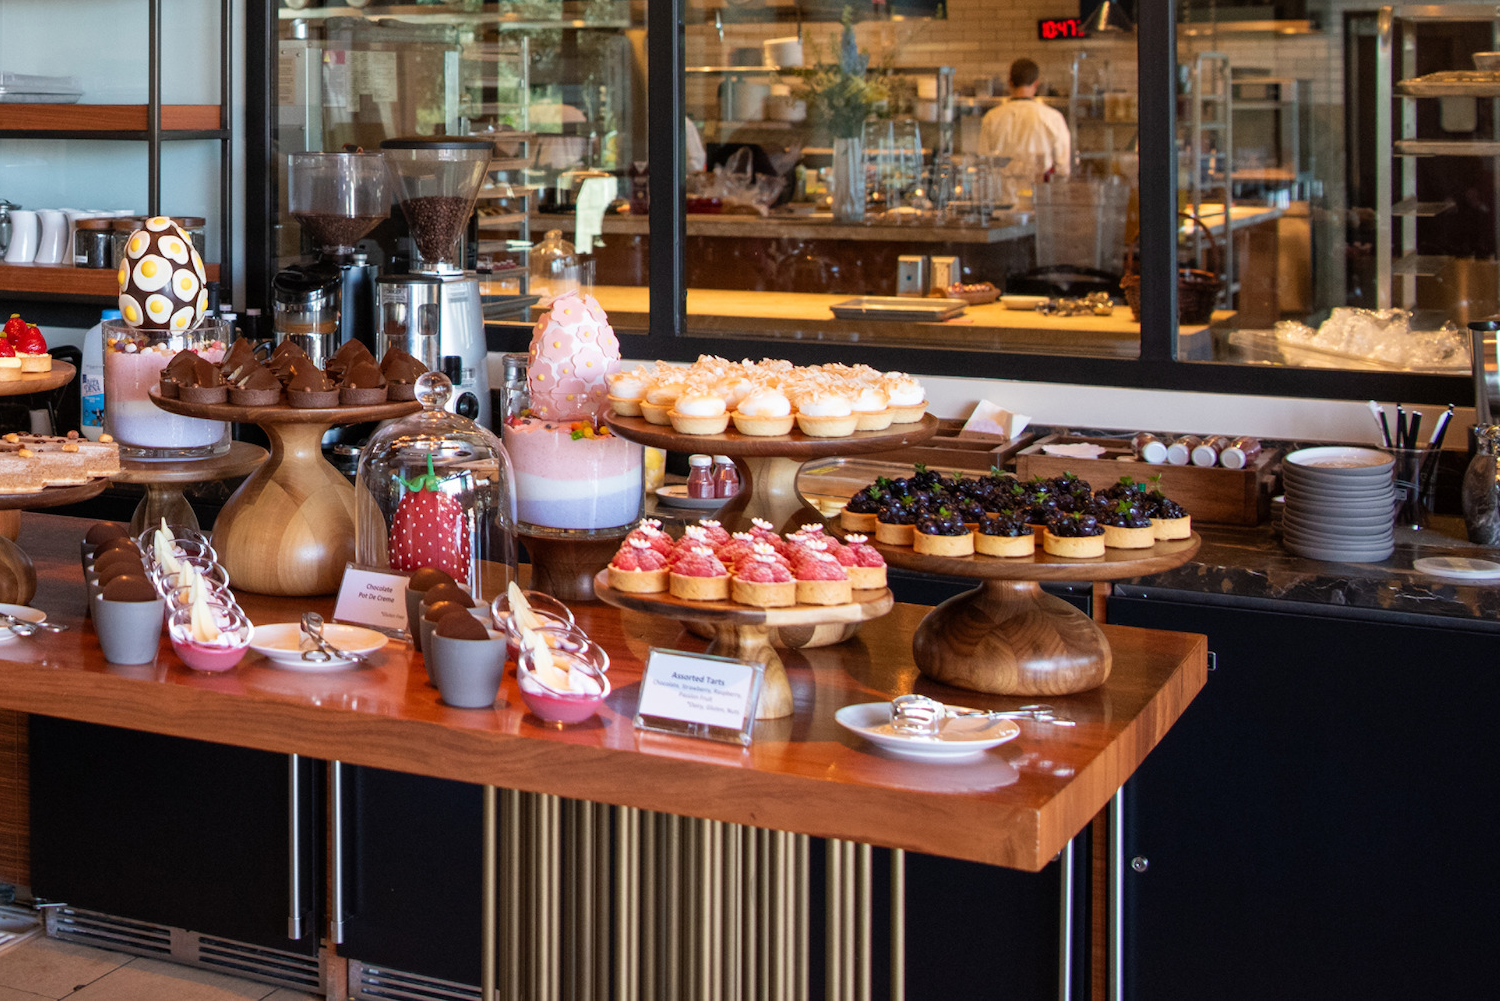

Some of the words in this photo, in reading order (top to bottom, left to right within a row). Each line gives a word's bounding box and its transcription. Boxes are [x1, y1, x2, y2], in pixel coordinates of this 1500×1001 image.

[367, 583, 393, 593] Chocolate
[377, 595, 394, 603] Creme
[671, 672, 704, 682] Assorted
[707, 676, 725, 686] Tarts
